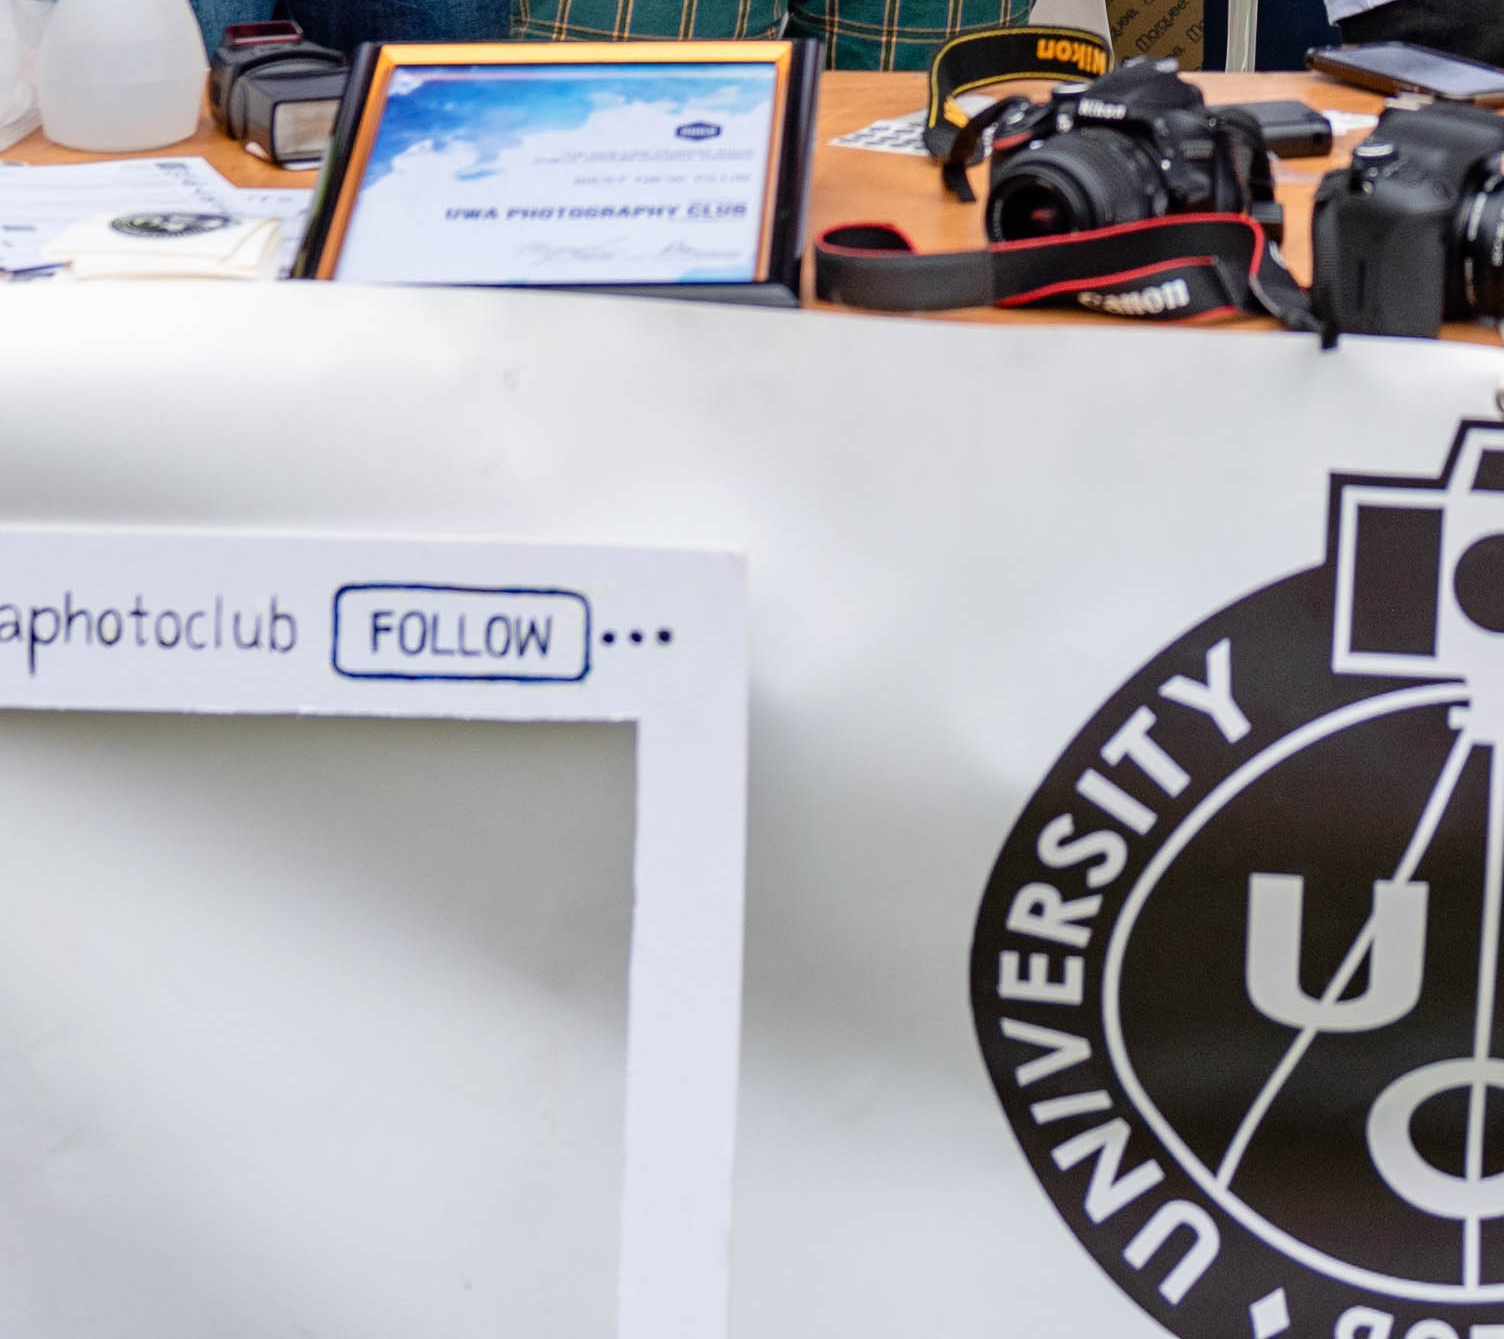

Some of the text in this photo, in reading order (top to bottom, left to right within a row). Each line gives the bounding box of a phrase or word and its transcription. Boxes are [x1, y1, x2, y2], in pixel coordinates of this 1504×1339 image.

[1077, 97, 1127, 120] Nikon
[445, 207, 498, 220] UWA
[506, 204, 680, 221] PHOTOGRAPHY
[1077, 278, 1191, 316] Canon
[370, 608, 553, 660] FOLLOW
[999, 638, 1253, 1306] UNIVERSITY
